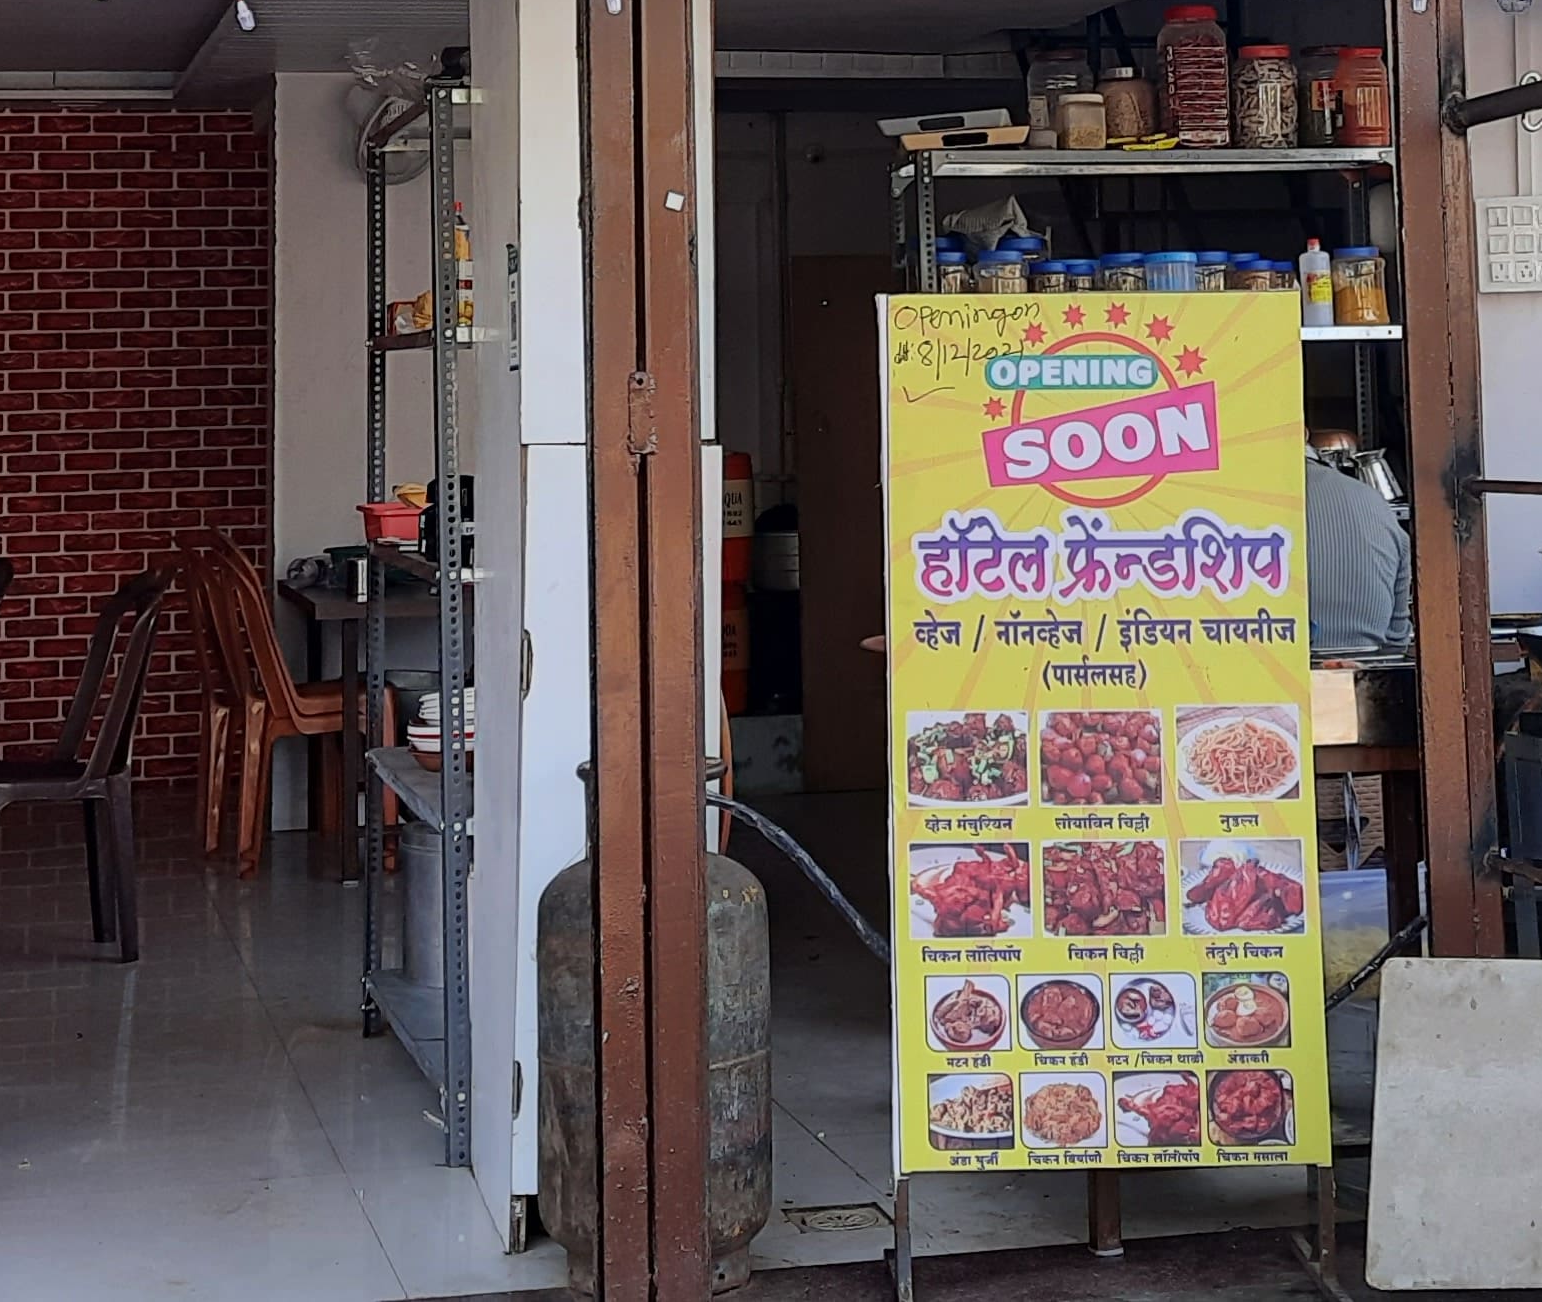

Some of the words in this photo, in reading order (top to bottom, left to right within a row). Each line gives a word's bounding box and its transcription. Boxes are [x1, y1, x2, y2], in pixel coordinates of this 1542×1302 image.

[990, 358, 1155, 388] OPENING
[1002, 402, 1211, 480] SOON
[917, 516, 1049, 594] हॉटेल
[914, 611, 961, 650] व्हेज
[994, 609, 1083, 650] नॉनव्हेज
[1116, 608, 1192, 652] इंडियन
[1199, 608, 1296, 645] चायनीज
[922, 945, 961, 963] चिकन
[1068, 944, 1108, 961] चिकन
[1243, 942, 1283, 960] चिकन
